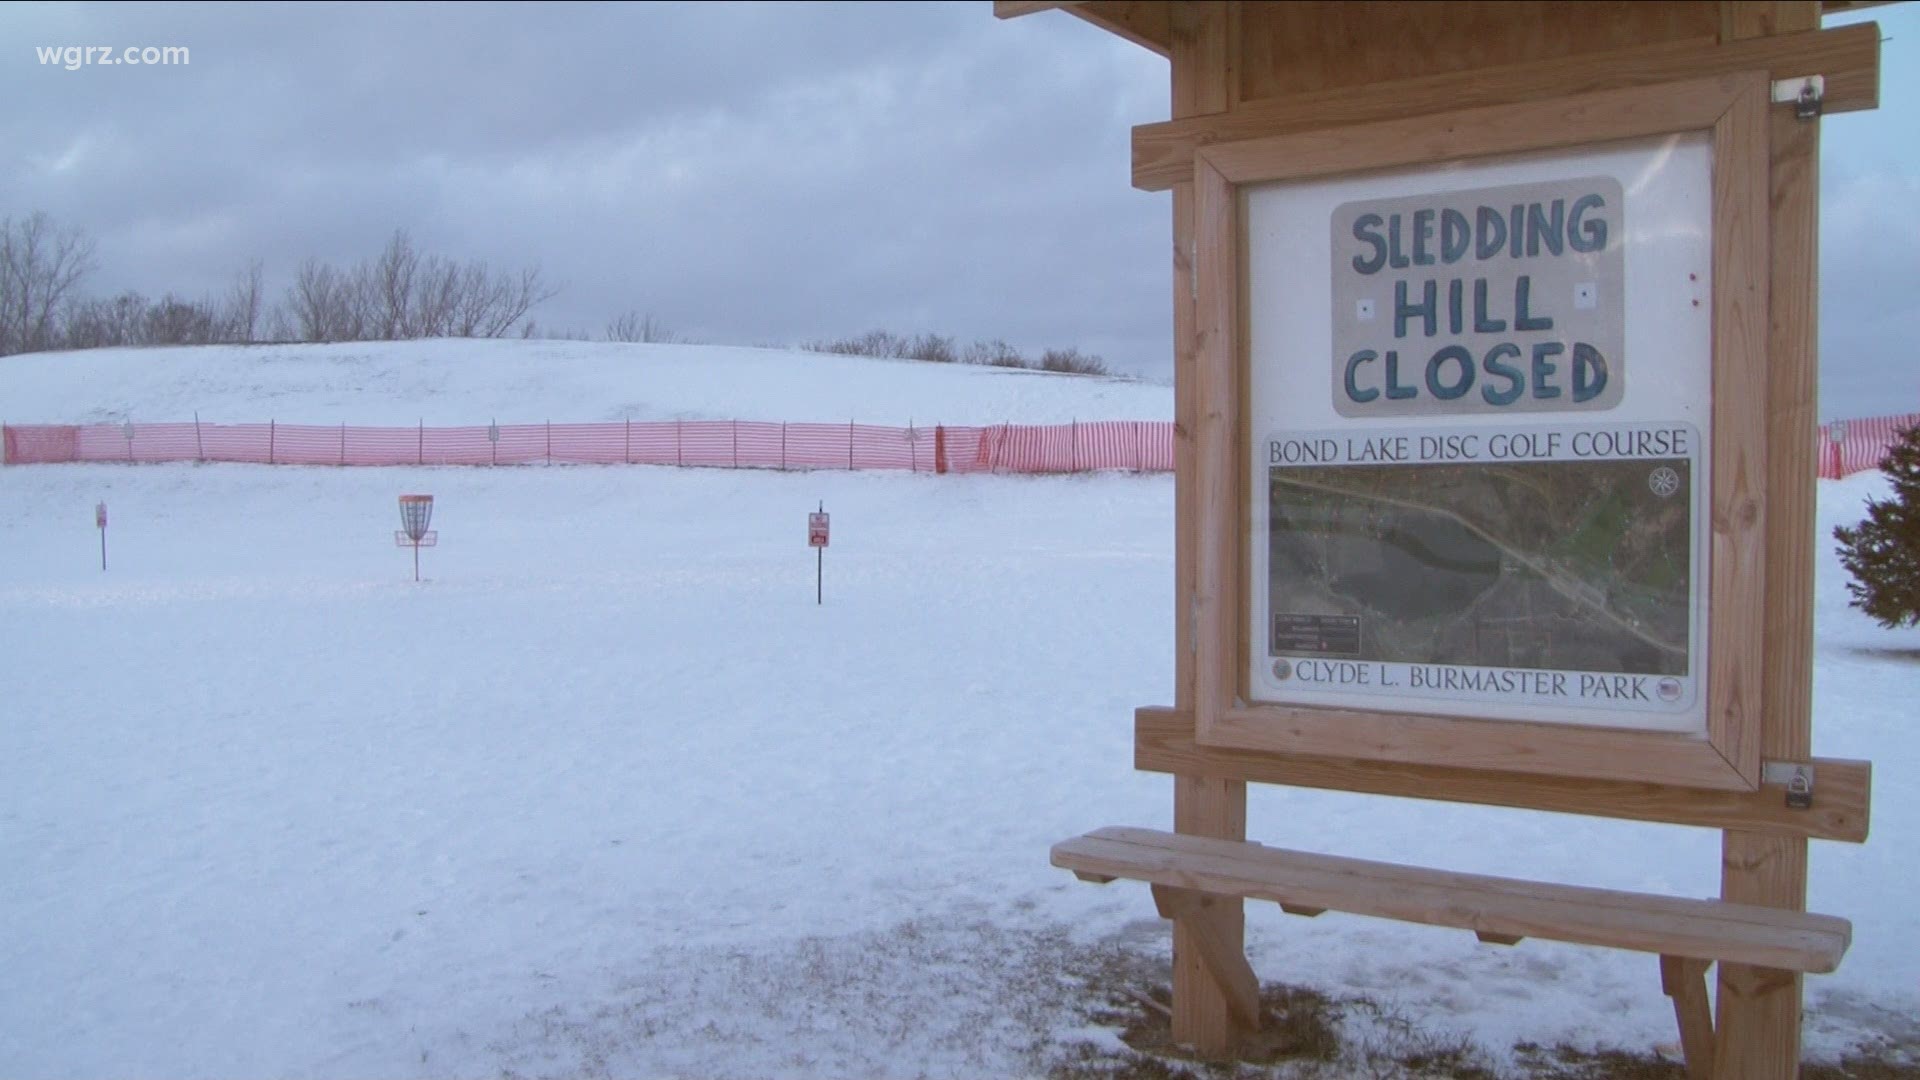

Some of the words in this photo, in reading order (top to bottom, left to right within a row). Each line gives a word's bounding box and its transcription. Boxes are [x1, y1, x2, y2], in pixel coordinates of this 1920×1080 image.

[1352, 193, 1608, 275] SLEDDING
[1394, 275, 1554, 338] HILL
[1344, 342, 1608, 406] CLOSED
[1269, 439, 1338, 463] BOND
[1347, 437, 1409, 462] LAKE
[1420, 435, 1479, 460] DISC
[1488, 432, 1562, 458] GOLF
[1572, 429, 1688, 456] COURSE
[1296, 660, 1370, 684] CLYDE
[1381, 665, 1399, 686] L.
[1410, 665, 1568, 696] BURMASTER
[1579, 674, 1650, 701] PARK
